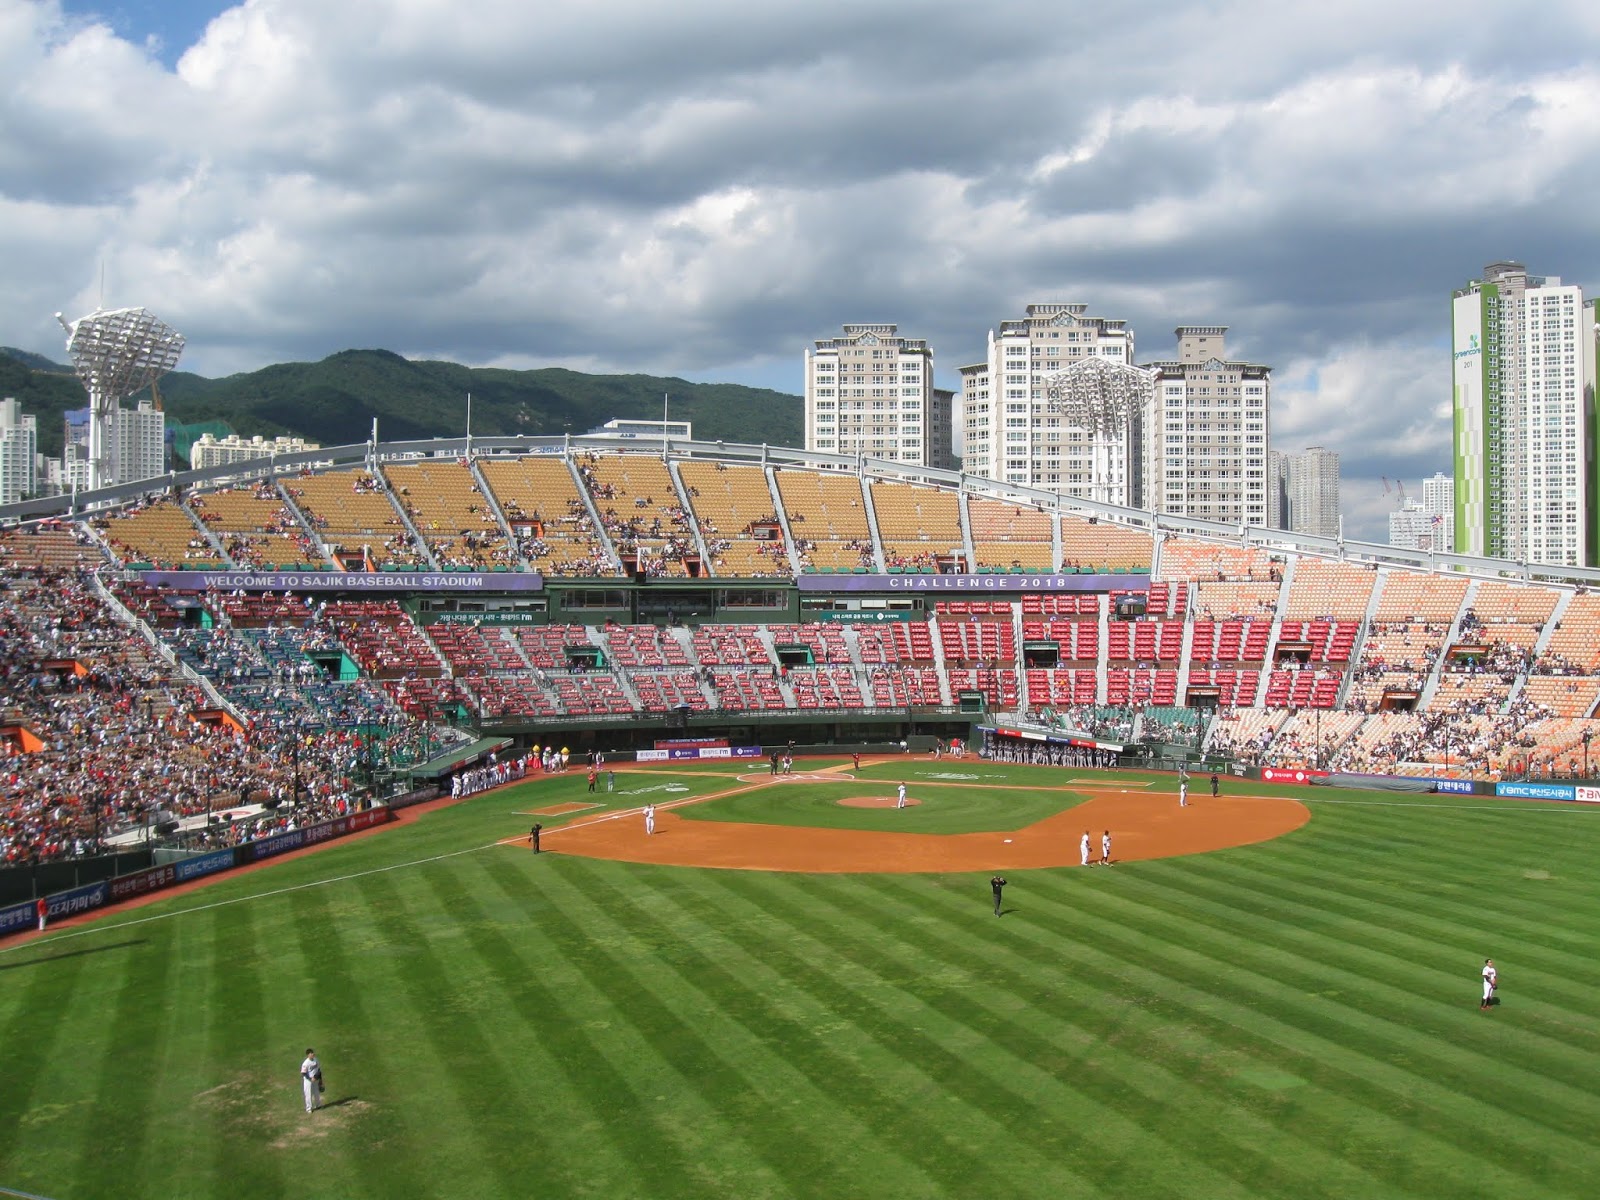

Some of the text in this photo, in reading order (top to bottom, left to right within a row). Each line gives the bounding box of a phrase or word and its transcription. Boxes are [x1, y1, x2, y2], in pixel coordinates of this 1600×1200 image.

[1463, 361, 1473, 369] 201
[204, 576, 483, 587] WELCOME TO SAJIK BASEBALL STADIUM
[889, 578, 1066, 587] CHALLENGE 2018
[1432, 780, 1472, 792] 강펜테리움
[1529, 788, 1572, 798] 부산도시공사
[48, 895, 88, 917] CE지키미
